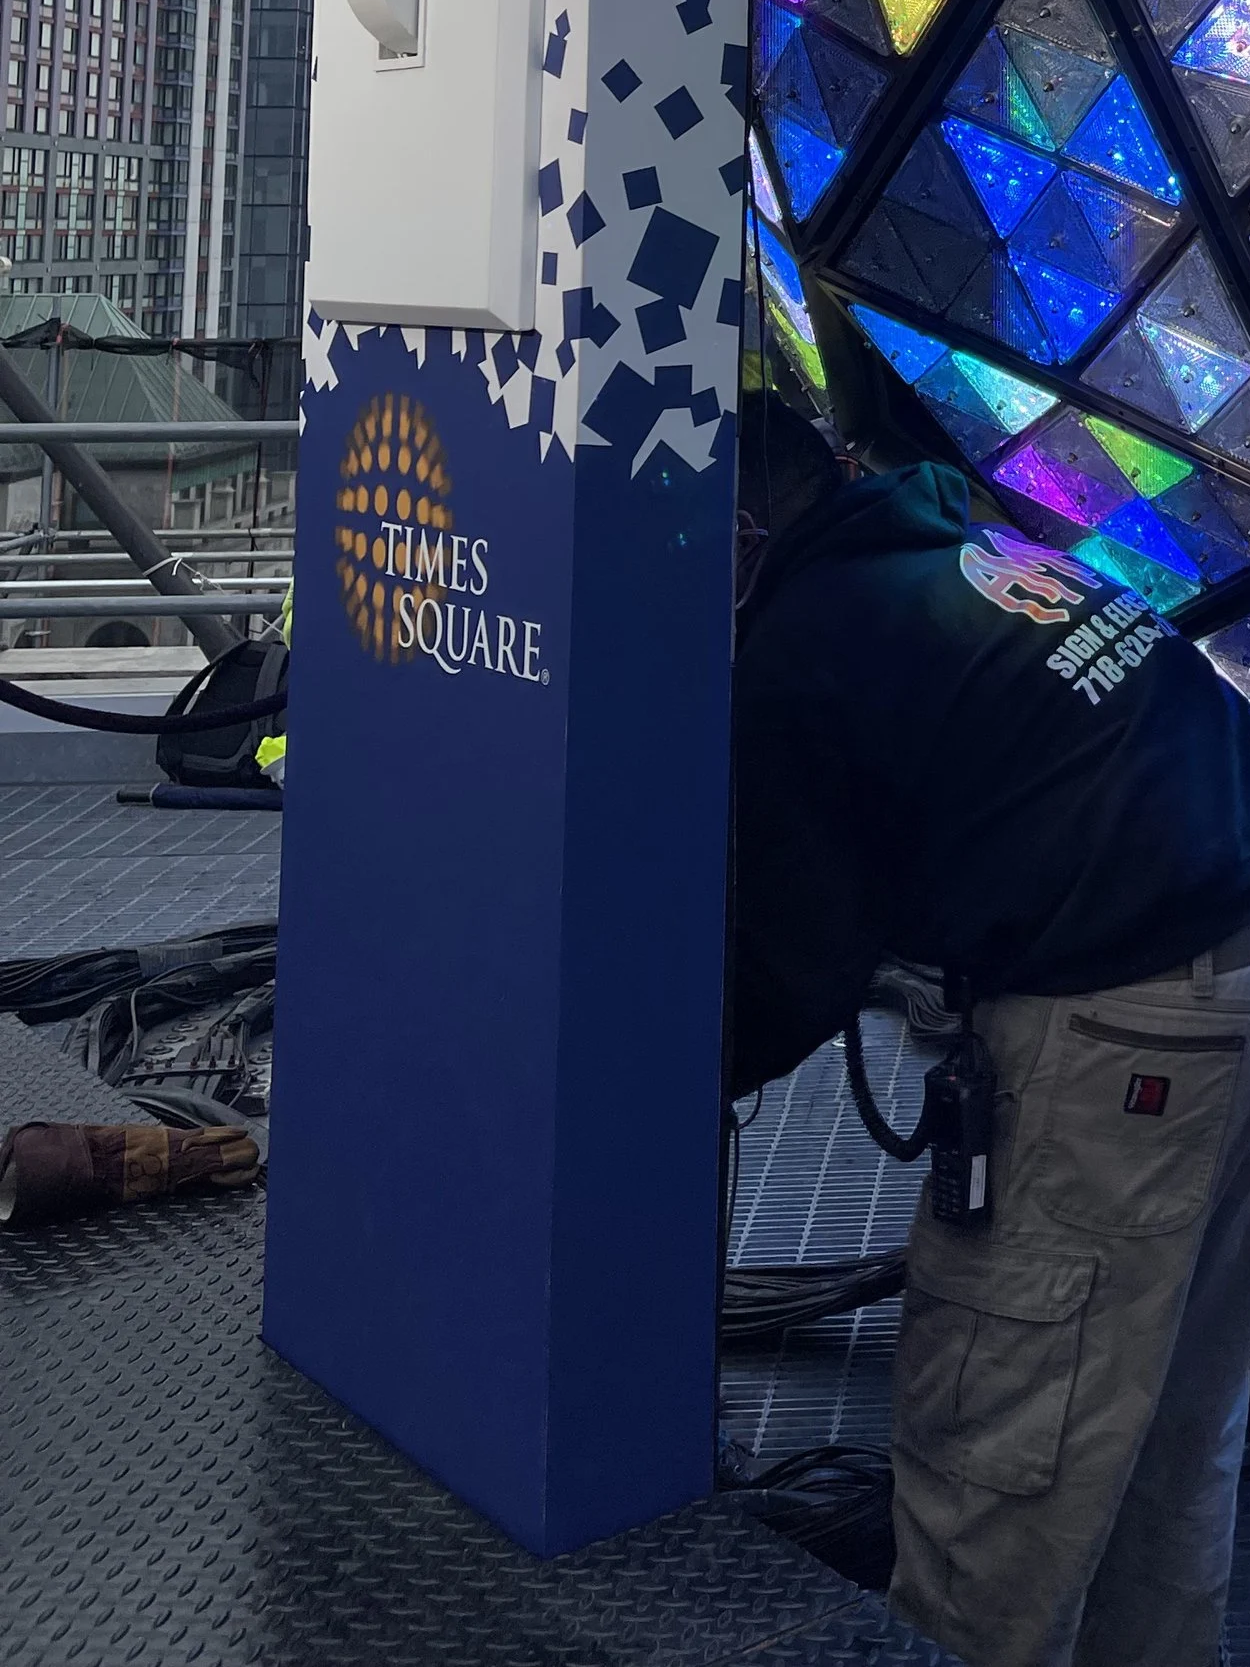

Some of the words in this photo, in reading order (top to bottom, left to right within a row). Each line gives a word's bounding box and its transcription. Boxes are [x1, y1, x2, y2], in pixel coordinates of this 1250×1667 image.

[380, 521, 489, 596] TIMES
[1046, 623, 1105, 679] SIGN
[1090, 614, 1120, 639] &
